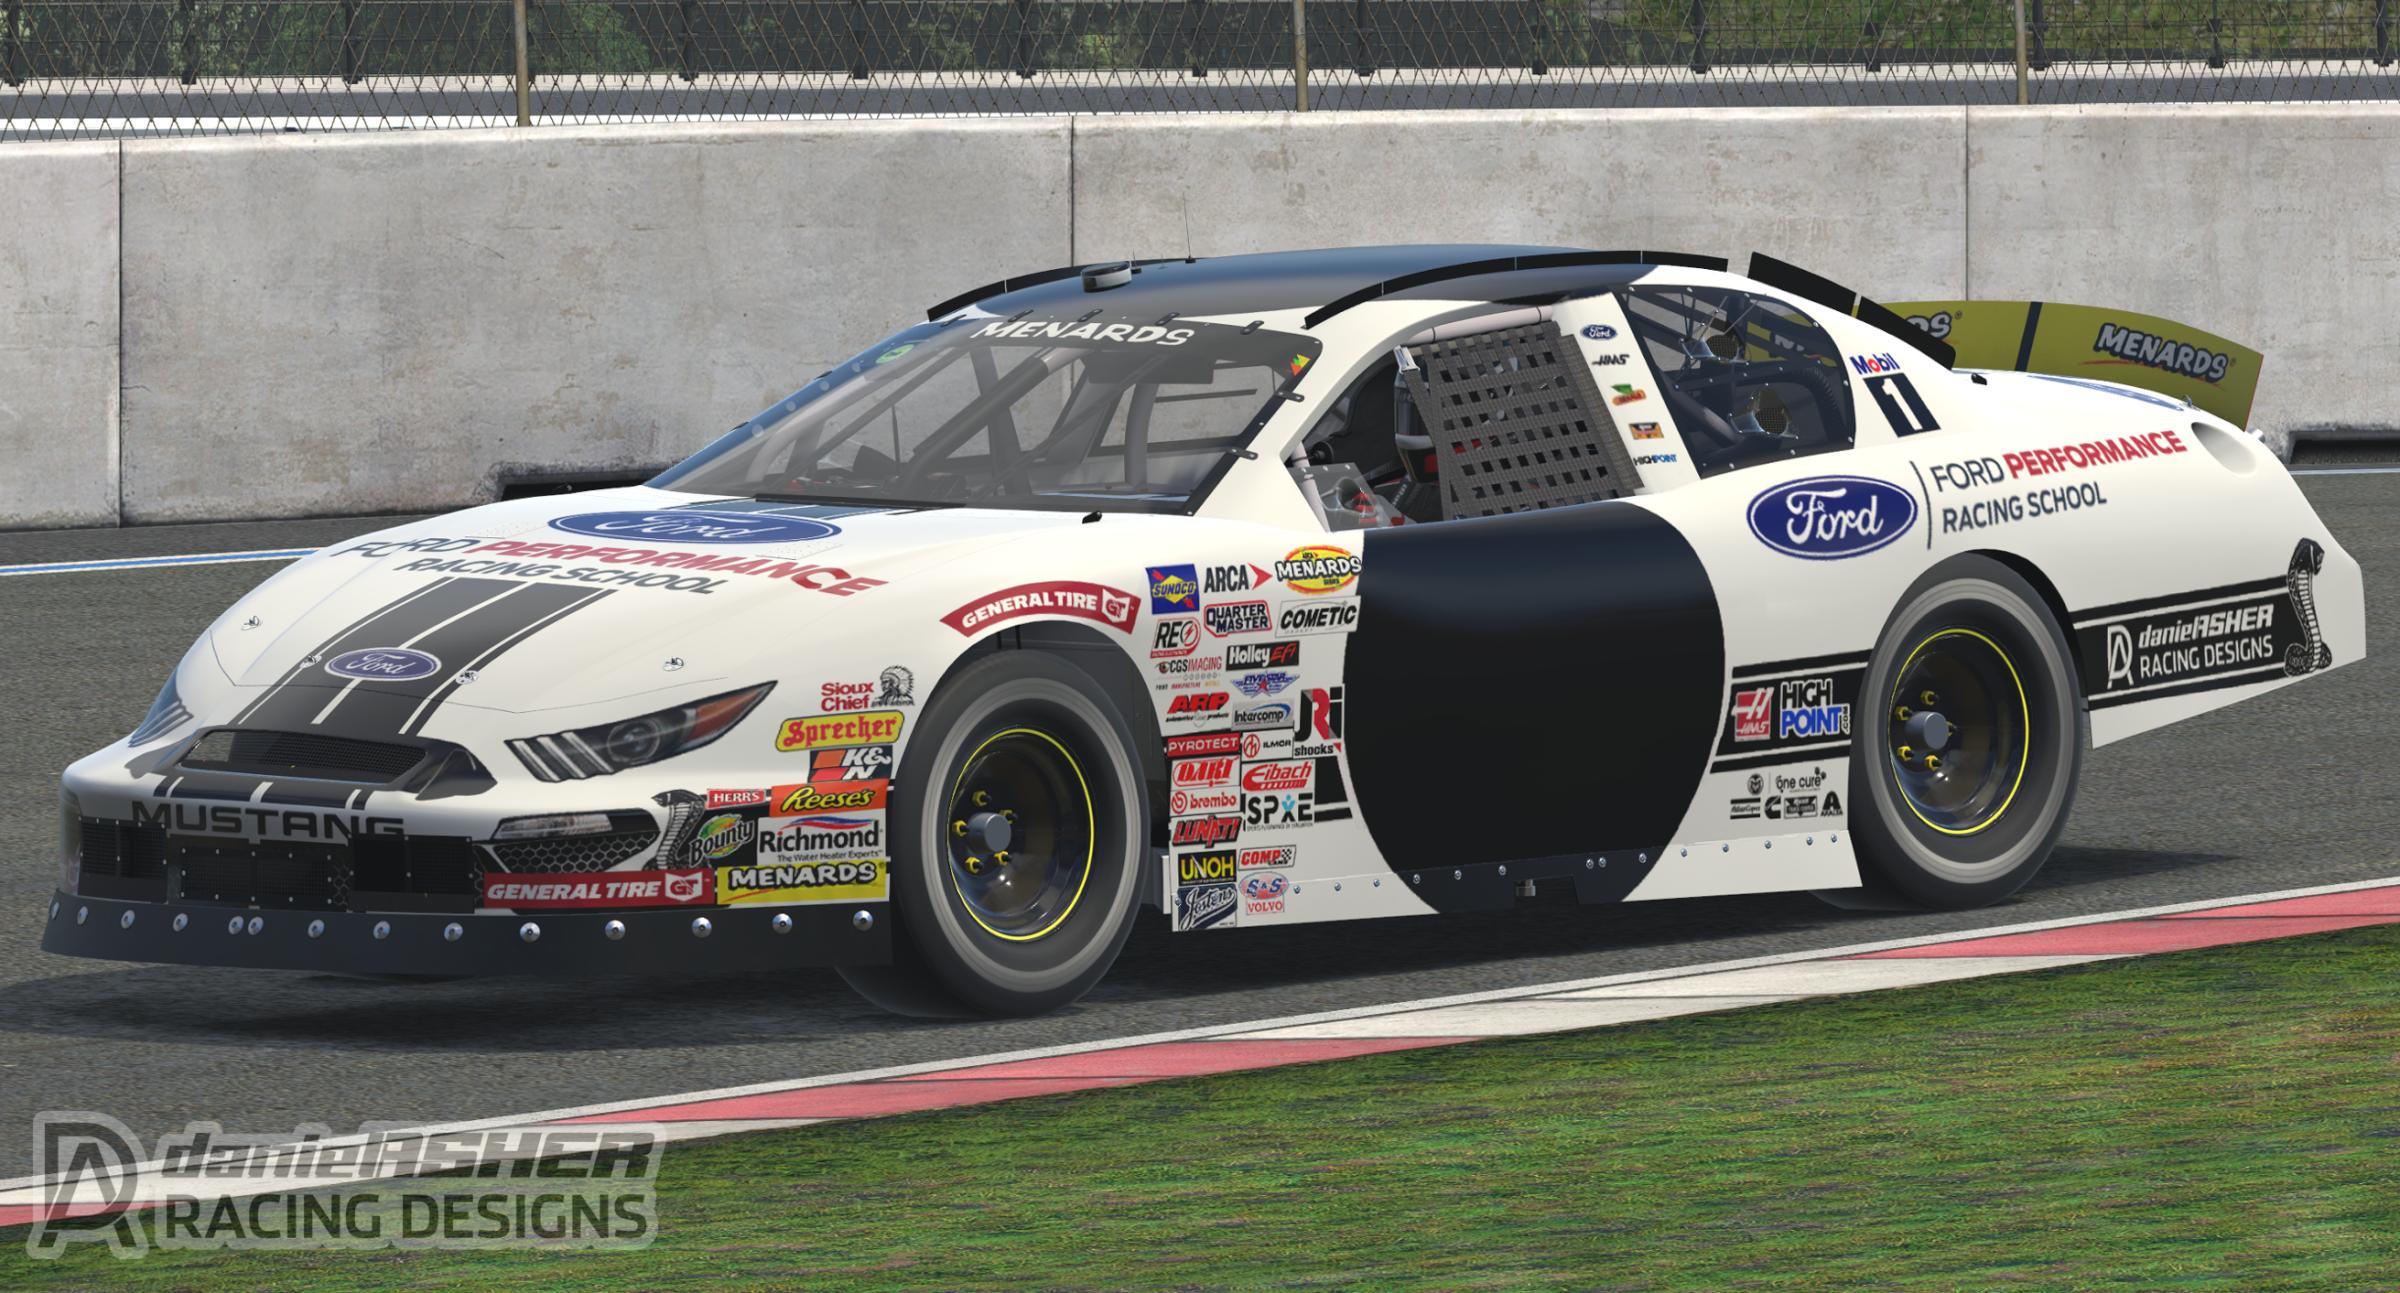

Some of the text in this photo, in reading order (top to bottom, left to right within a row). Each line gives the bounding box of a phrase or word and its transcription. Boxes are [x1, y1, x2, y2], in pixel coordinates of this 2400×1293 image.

[970, 321, 1195, 346] MENARDS
[1850, 352, 1900, 375] Mobil
[2096, 323, 2228, 383] MENARDS
[1878, 377, 1922, 431] 1
[1930, 430, 2188, 493] FORD PERFORMANCE
[1785, 487, 1884, 545] Ford
[1942, 481, 2107, 534] RACING SCHOOL
[596, 513, 788, 539] Ford
[330, 537, 888, 597] FORD PERFORMANCE
[392, 558, 729, 594] RACING SCHOOL
[1204, 564, 1249, 593] ARCA
[1276, 556, 1361, 581] MENARDS
[1153, 581, 1196, 597] SUNOCO
[962, 592, 1054, 628] GENERAL
[1053, 591, 1098, 611] TIRE
[1206, 602, 1267, 626] QUARTER
[1280, 605, 1357, 629] COMETIC
[1215, 616, 1268, 633] MASTER
[346, 652, 416, 675] Ford
[1229, 644, 1270, 667] Holley
[2140, 634, 2274, 679] RACING DESIGNS
[821, 682, 874, 696] Sioux
[1781, 679, 1832, 710] HIGH
[821, 694, 870, 712] Chief
[1167, 692, 1230, 714] ARP
[1234, 709, 1284, 723] Intercomp
[1781, 705, 1842, 738] POINT
[783, 714, 897, 748] Sprecher
[1168, 737, 1238, 751] PYROTECT
[1262, 739, 1291, 749] ILMOR
[1294, 744, 1334, 757] shocks
[1242, 761, 1313, 791] Eibach
[1799, 775, 1822, 788] cure
[782, 786, 876, 812] Reese's
[1189, 792, 1237, 809] brembo
[131, 801, 405, 839] MUSTANG
[1172, 815, 1241, 849] LUNATI
[691, 821, 754, 866] Bounty
[759, 819, 880, 853] Richmond
[777, 849, 879, 863] The Water Heater Experts
[1181, 855, 1234, 880] UNOH
[1241, 849, 1281, 866] COMP
[729, 862, 877, 890] MENARDS
[487, 883, 602, 900] GENERAL
[611, 880, 662, 898] TIRE
[1180, 887, 1236, 931] Jostens
[1248, 901, 1283, 913] VOLVO
